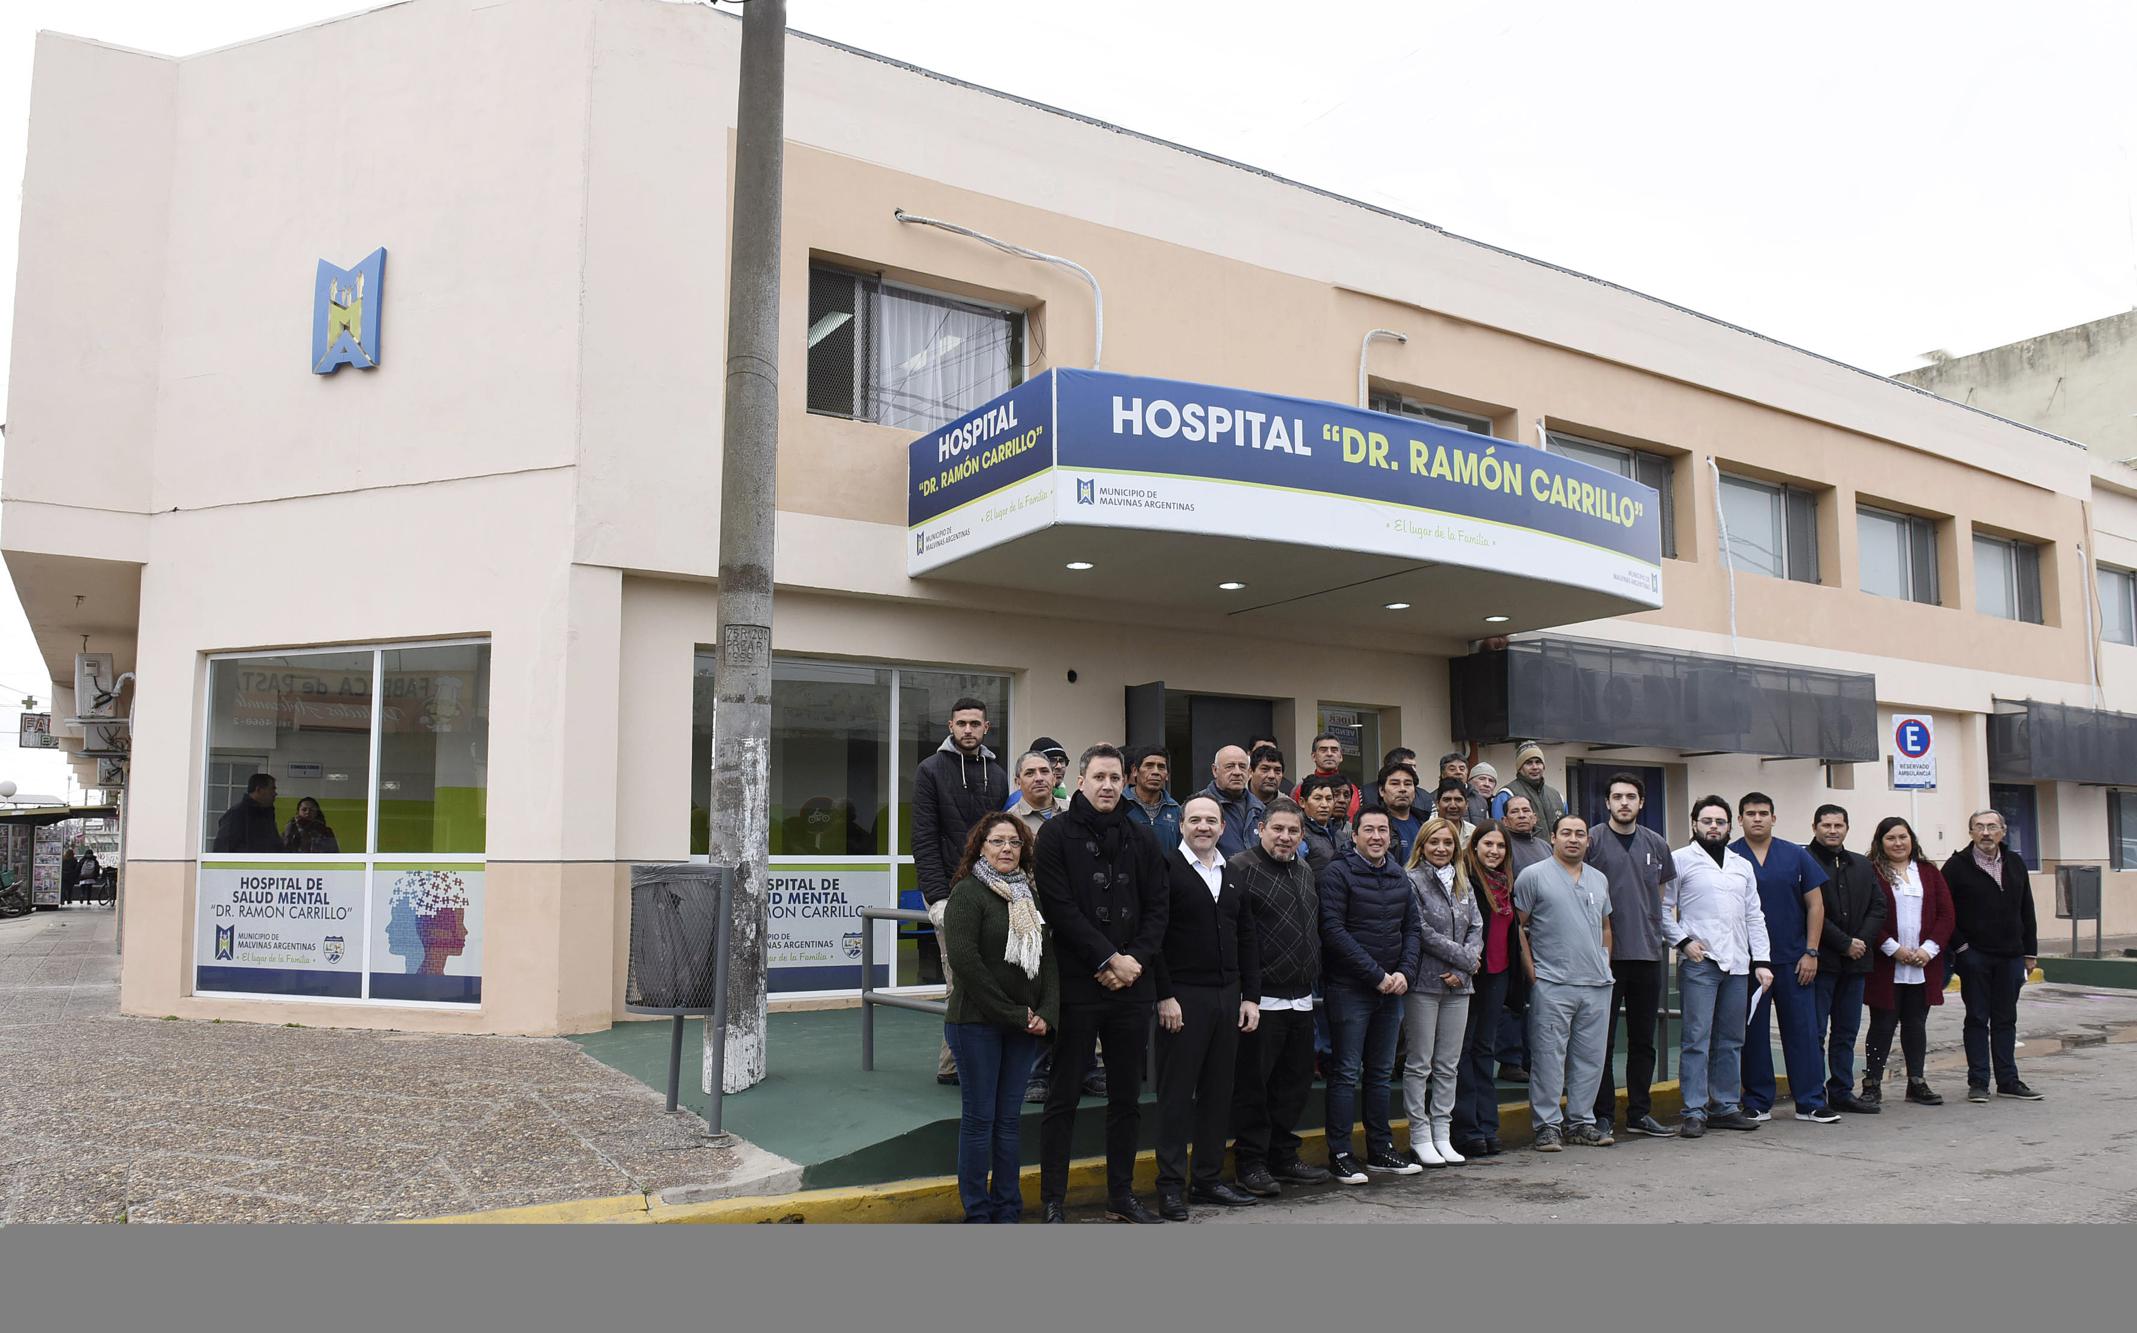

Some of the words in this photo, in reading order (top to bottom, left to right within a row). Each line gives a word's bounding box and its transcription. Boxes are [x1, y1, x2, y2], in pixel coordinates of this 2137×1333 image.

[938, 400, 1018, 463] HOSPITAL
[918, 475, 940, 498] “DR.
[941, 455, 980, 490] RAMÓN
[981, 425, 1043, 469] CARRILLO”
[1112, 395, 1312, 457] HOSPITAL
[1322, 423, 1399, 471] “DR.
[1409, 439, 1523, 497] RAMÓN
[1530, 468, 1644, 528] CARRILLO”
[1099, 487, 1145, 499] MUNICIPIO
[1146, 489, 1158, 499] DE
[1099, 497, 1143, 509] MALVINAS
[1144, 500, 1195, 512] ARGENTINAS
[1394, 519, 1407, 533] El
[1409, 520, 1431, 540] lugar
[1434, 525, 1445, 539] de
[1457, 529, 1489, 547] Familia
[1906, 726, 1921, 751] E
[240, 876, 302, 890] HOSPITAL
[306, 877, 323, 891] DE
[767, 878, 816, 891] SPITAL
[821, 878, 840, 890] DE
[232, 890, 274, 904] SALUD
[277, 891, 330, 905] MENTAL
[788, 892, 848, 904] MENTAL
[239, 904, 285, 918] RAMON
[238, 932, 271, 941] MUNICIPIO
[271, 933, 279, 941] DE
[238, 940, 272, 950] MALVINAS
[273, 941, 316, 951] ARGENTINAS
[783, 940, 834, 949] ARGENTINAS
[799, 951, 828, 961] Familia
